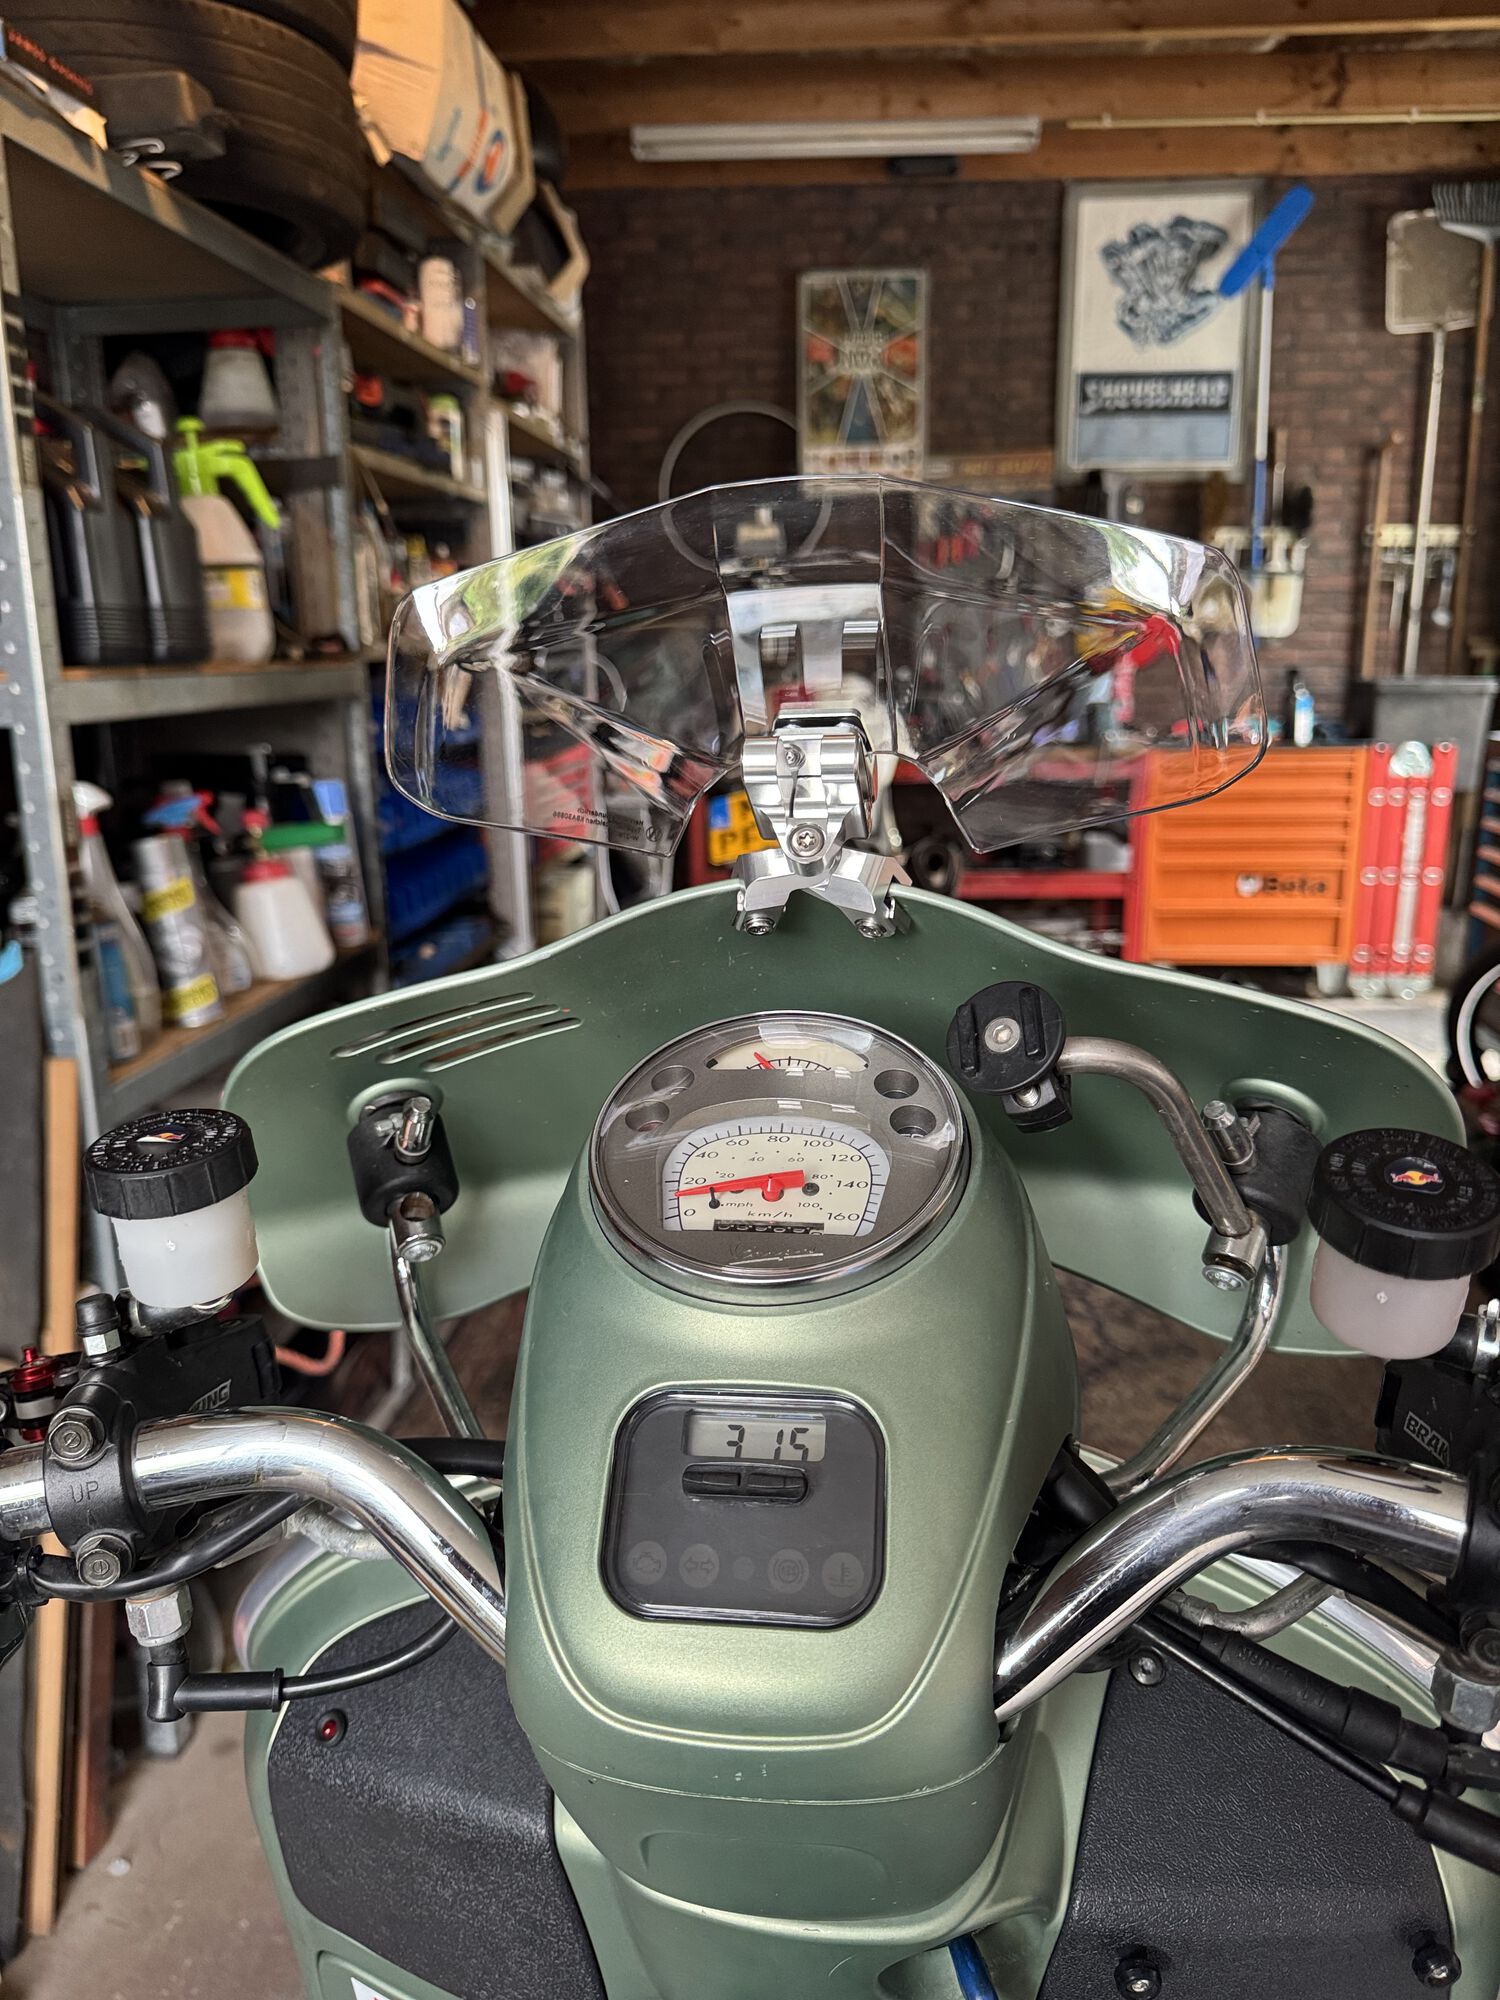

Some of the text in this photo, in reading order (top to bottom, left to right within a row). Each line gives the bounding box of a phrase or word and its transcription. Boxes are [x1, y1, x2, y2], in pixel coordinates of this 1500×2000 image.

[725, 1138, 750, 1147] 60
[767, 1135, 791, 1143] 80
[802, 1139, 834, 1148] 100
[695, 1151, 719, 1159] 40
[831, 1153, 862, 1163] 120
[684, 1176, 707, 1185] 20
[836, 1180, 869, 1189] 140
[726, 1201, 754, 1209] mph
[683, 1208, 696, 1217] 0
[747, 1210, 793, 1218] km/h
[827, 1212, 860, 1221] 160
[69, 1480, 99, 1504] UP
